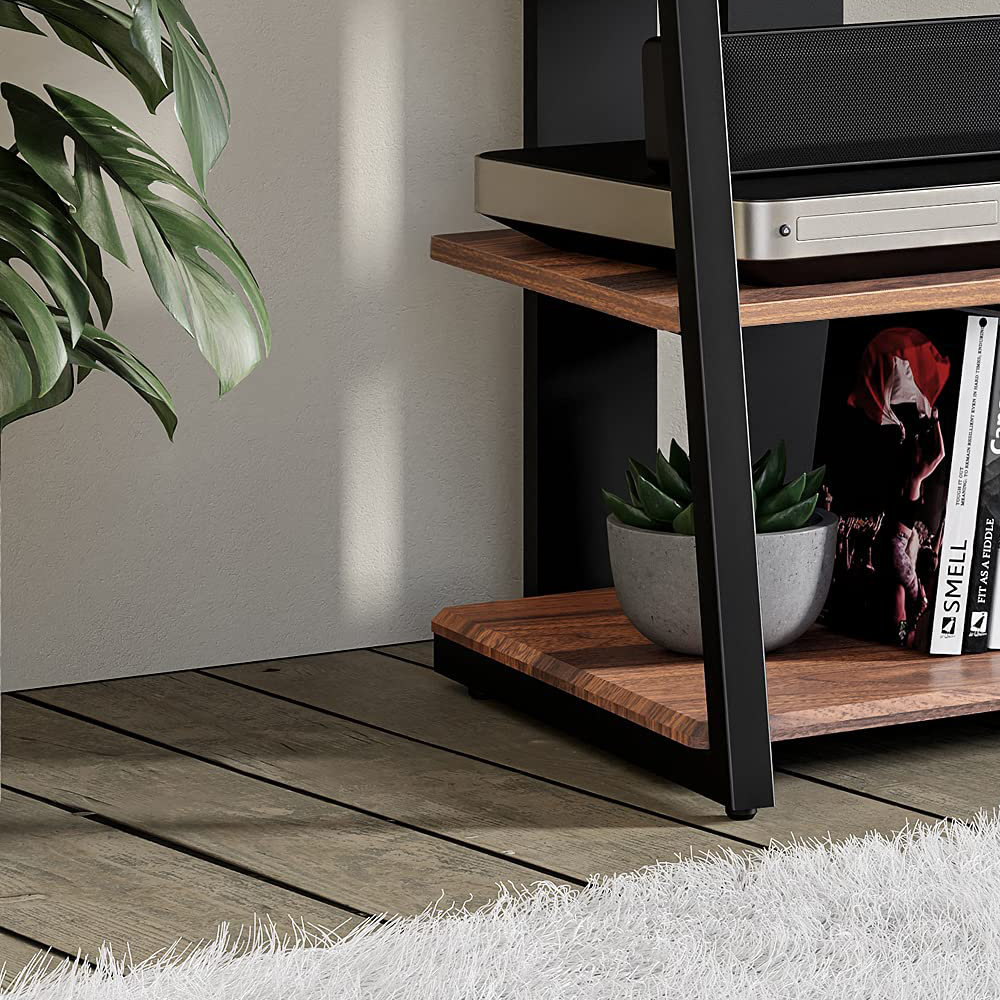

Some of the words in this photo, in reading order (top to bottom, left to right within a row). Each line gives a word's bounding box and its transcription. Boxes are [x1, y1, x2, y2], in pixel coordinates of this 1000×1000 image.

[982, 518, 995, 559] FIDDLE
[981, 560, 990, 570] A
[943, 539, 968, 613] SMELL
[980, 570, 989, 585] AS
[977, 585, 987, 604] FIT
